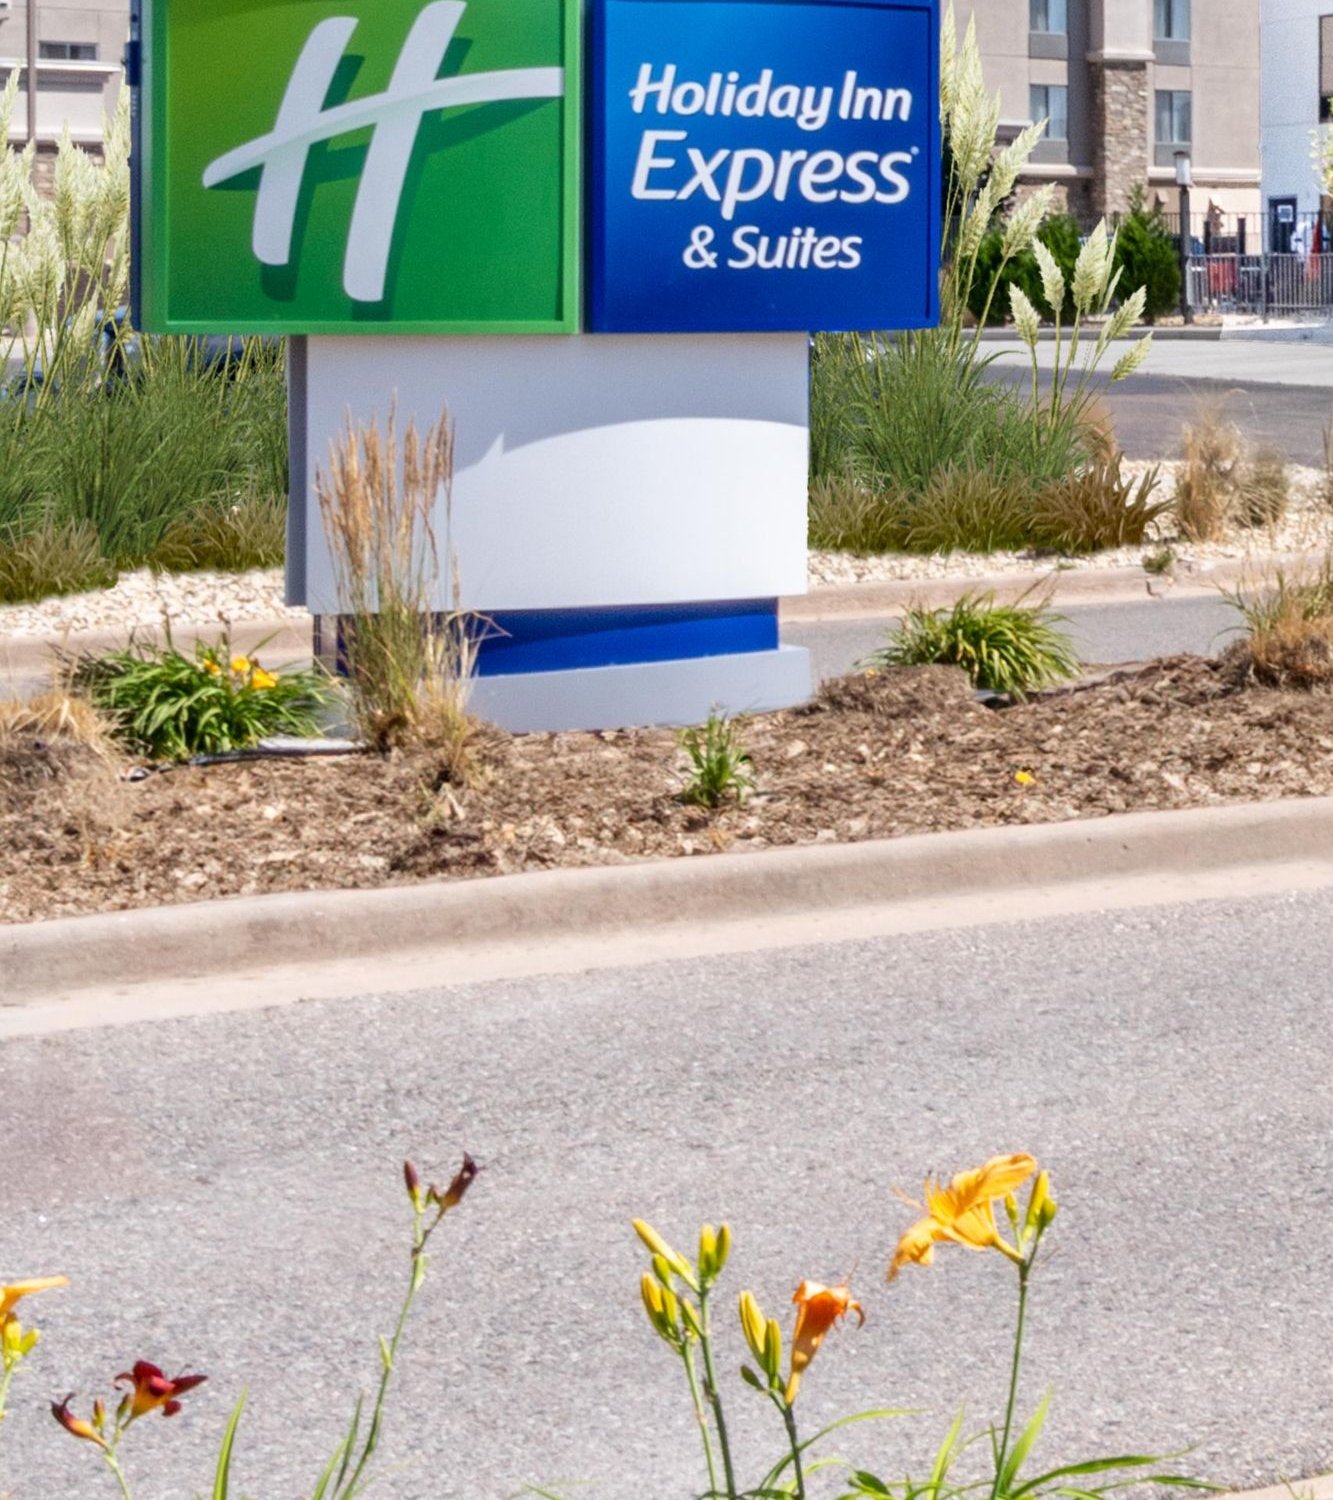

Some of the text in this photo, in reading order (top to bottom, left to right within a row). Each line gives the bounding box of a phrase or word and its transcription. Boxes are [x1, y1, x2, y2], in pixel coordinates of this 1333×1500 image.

[629, 63, 913, 131] Holiday Inn
[631, 130, 914, 220] Express
[683, 225, 863, 269] & Suites
